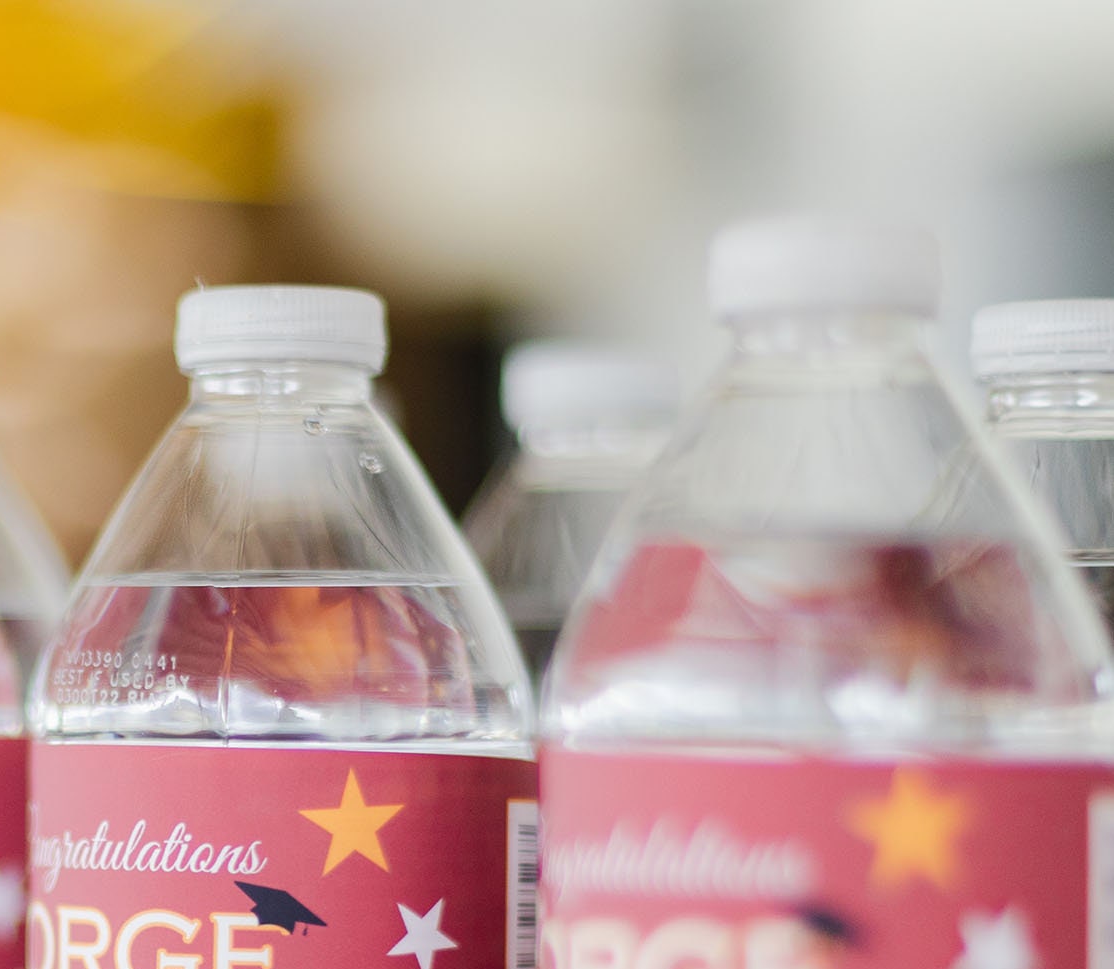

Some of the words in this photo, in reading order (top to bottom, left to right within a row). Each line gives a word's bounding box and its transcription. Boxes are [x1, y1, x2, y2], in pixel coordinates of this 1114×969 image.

[53, 668, 84, 686] BEST
[110, 671, 154, 690] USED
[165, 673, 190, 690] BY
